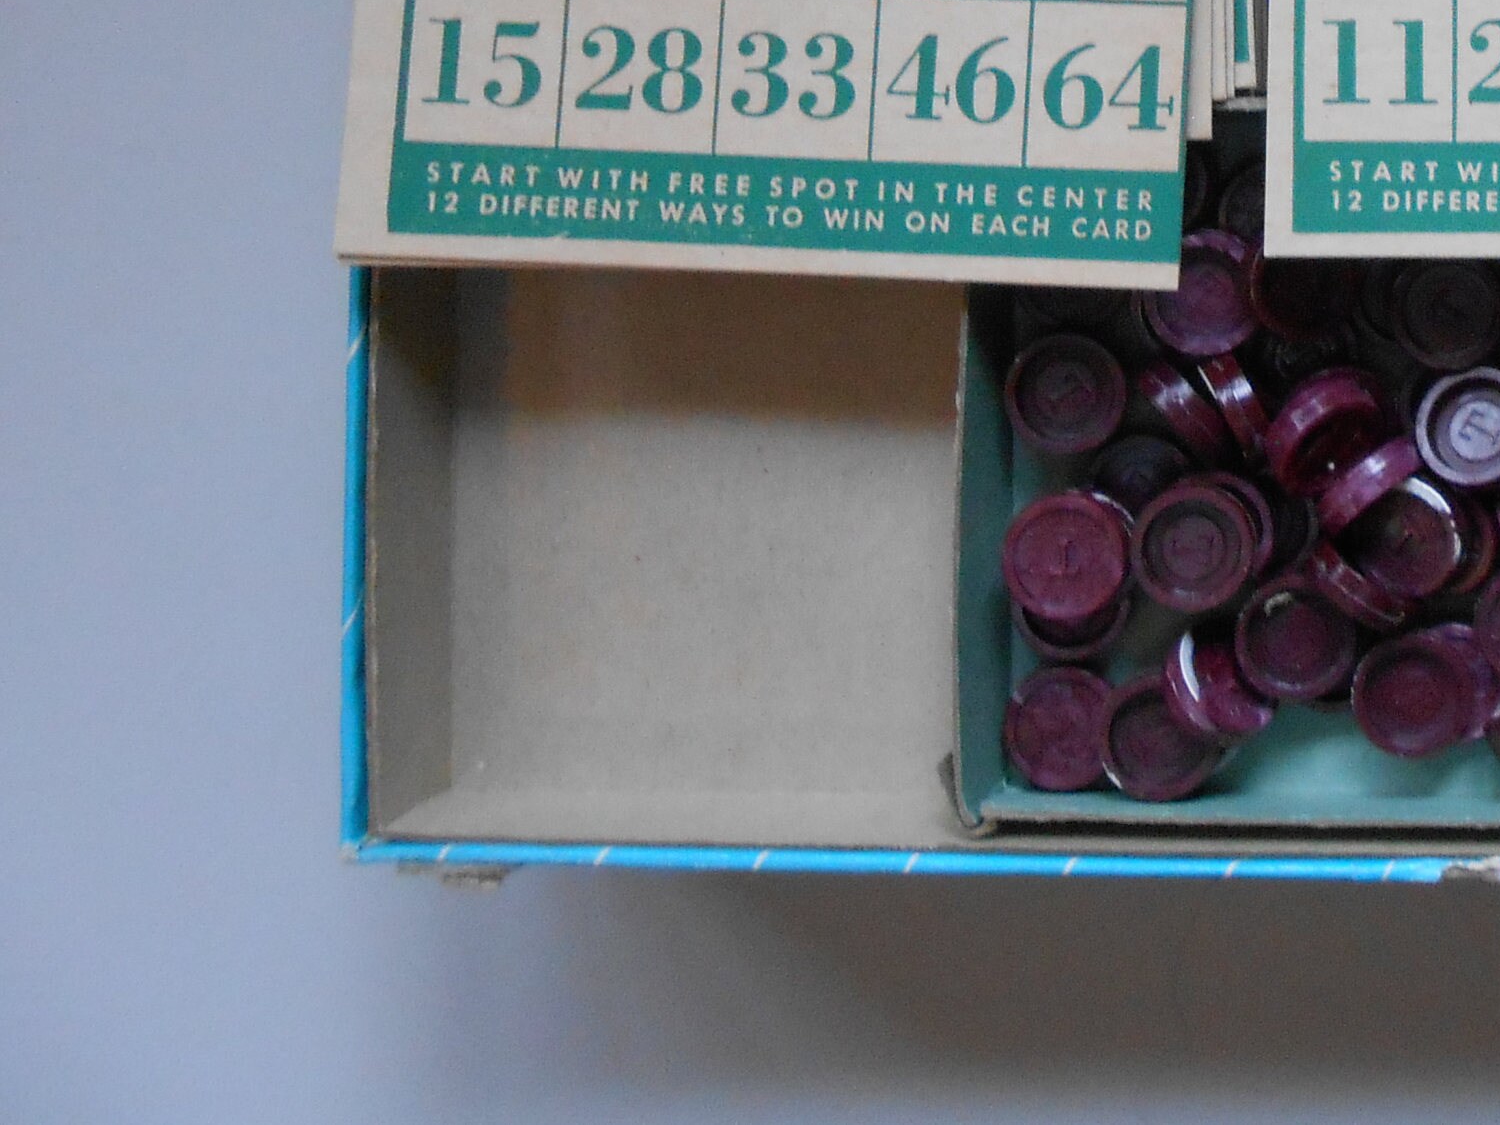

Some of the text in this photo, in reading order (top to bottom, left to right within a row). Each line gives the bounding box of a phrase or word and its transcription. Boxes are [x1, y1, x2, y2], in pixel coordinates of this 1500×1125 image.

[424, 19, 1174, 130] 15 28 33 46 64
[1324, 21, 1435, 104] 11
[427, 160, 1152, 212] START WITH FREE SPOT IN THE CENTER
[1329, 159, 1439, 183] START
[428, 190, 1152, 241] 12 DIFFERENT WAYS TO WIN ON EACH CARD
[1332, 188, 1363, 212] 12
